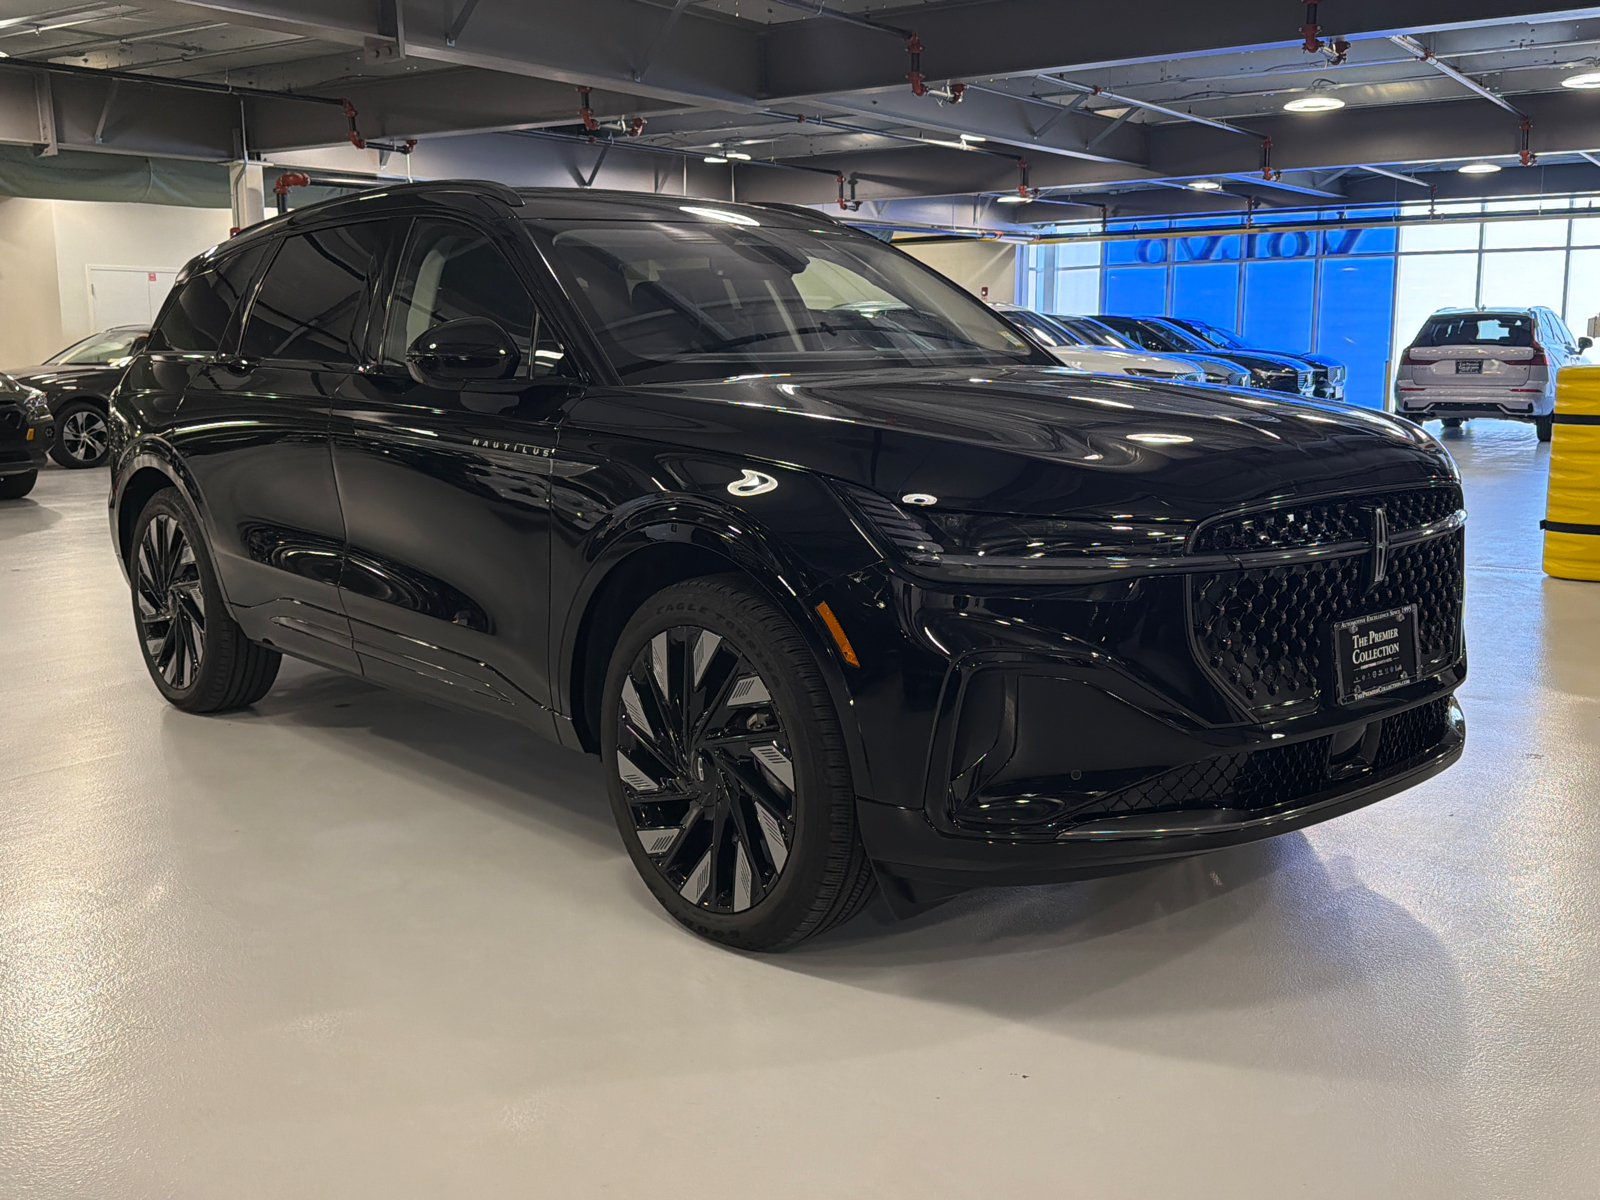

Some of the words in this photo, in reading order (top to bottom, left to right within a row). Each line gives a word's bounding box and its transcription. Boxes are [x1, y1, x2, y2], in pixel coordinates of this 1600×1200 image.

[472, 438, 549, 457] NAUTILUS
[655, 602, 709, 616] EAGLE
[1340, 617, 1366, 629] AUTOMOTIVE
[1366, 612, 1389, 623] EXCELLENCE
[1352, 634, 1369, 649] THE
[1368, 628, 1399, 645] PREMIER
[1352, 642, 1400, 665] COLLECTION
